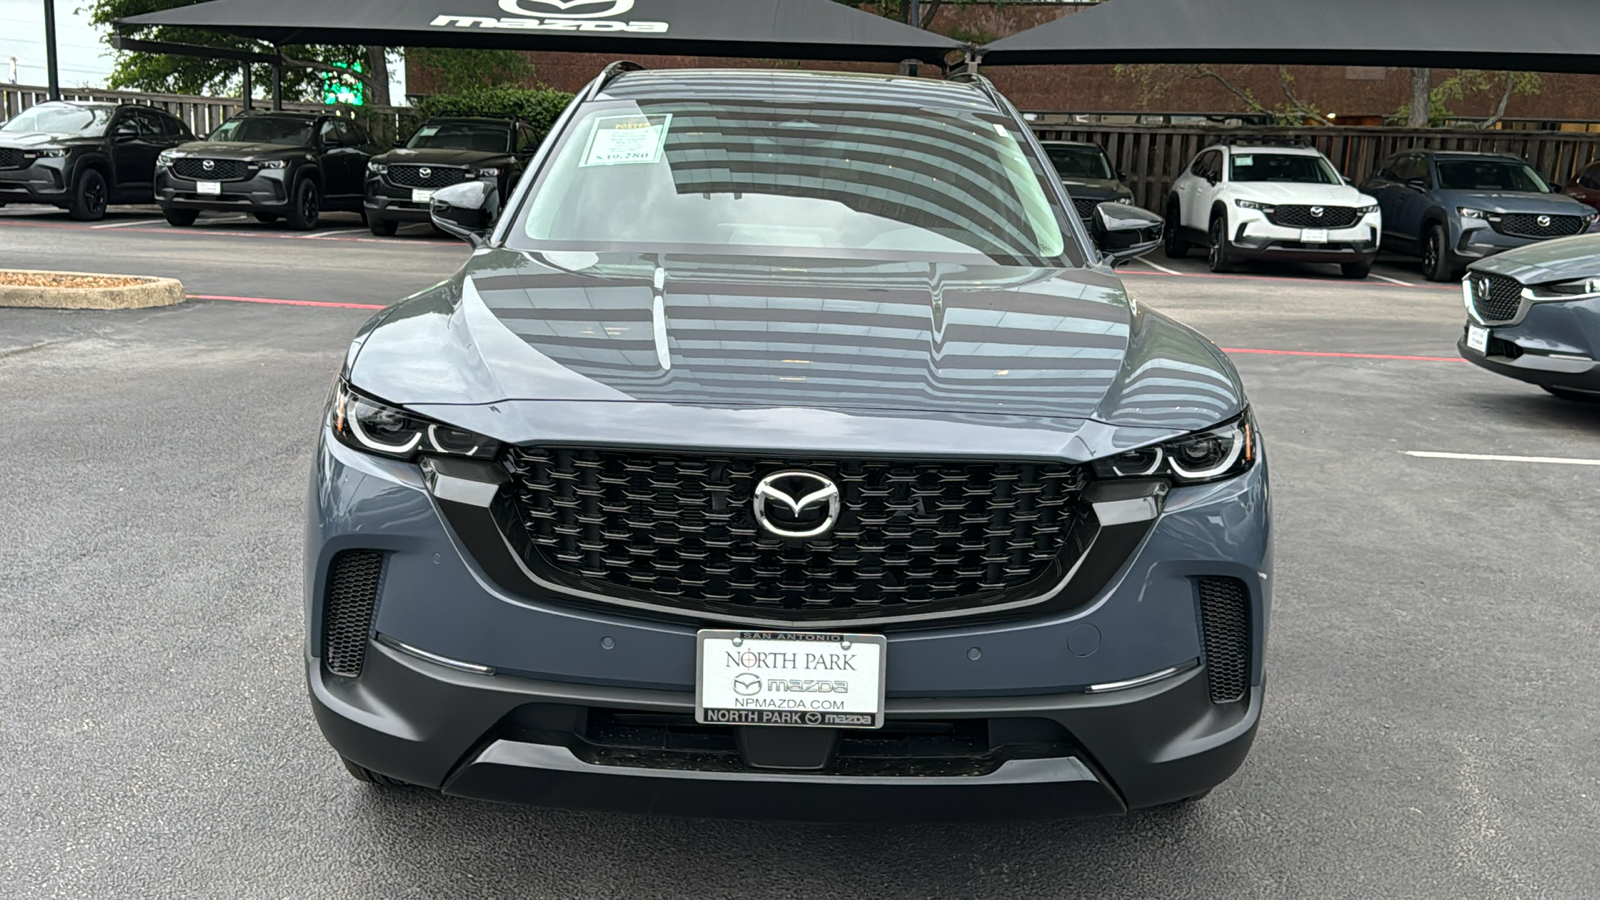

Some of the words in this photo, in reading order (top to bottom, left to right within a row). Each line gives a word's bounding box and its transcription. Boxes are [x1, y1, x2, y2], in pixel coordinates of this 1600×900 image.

[430, 14, 669, 33] mazda
[743, 632, 772, 641] SAN
[776, 633, 841, 642] ANTONIO
[725, 650, 798, 669] NORTH
[805, 653, 857, 671] PARK
[767, 678, 848, 694] mazda
[734, 697, 845, 710] NPMAZDA.COM
[707, 710, 758, 723] NORTH
[763, 711, 802, 724] PARK
[825, 715, 872, 725] mazda
